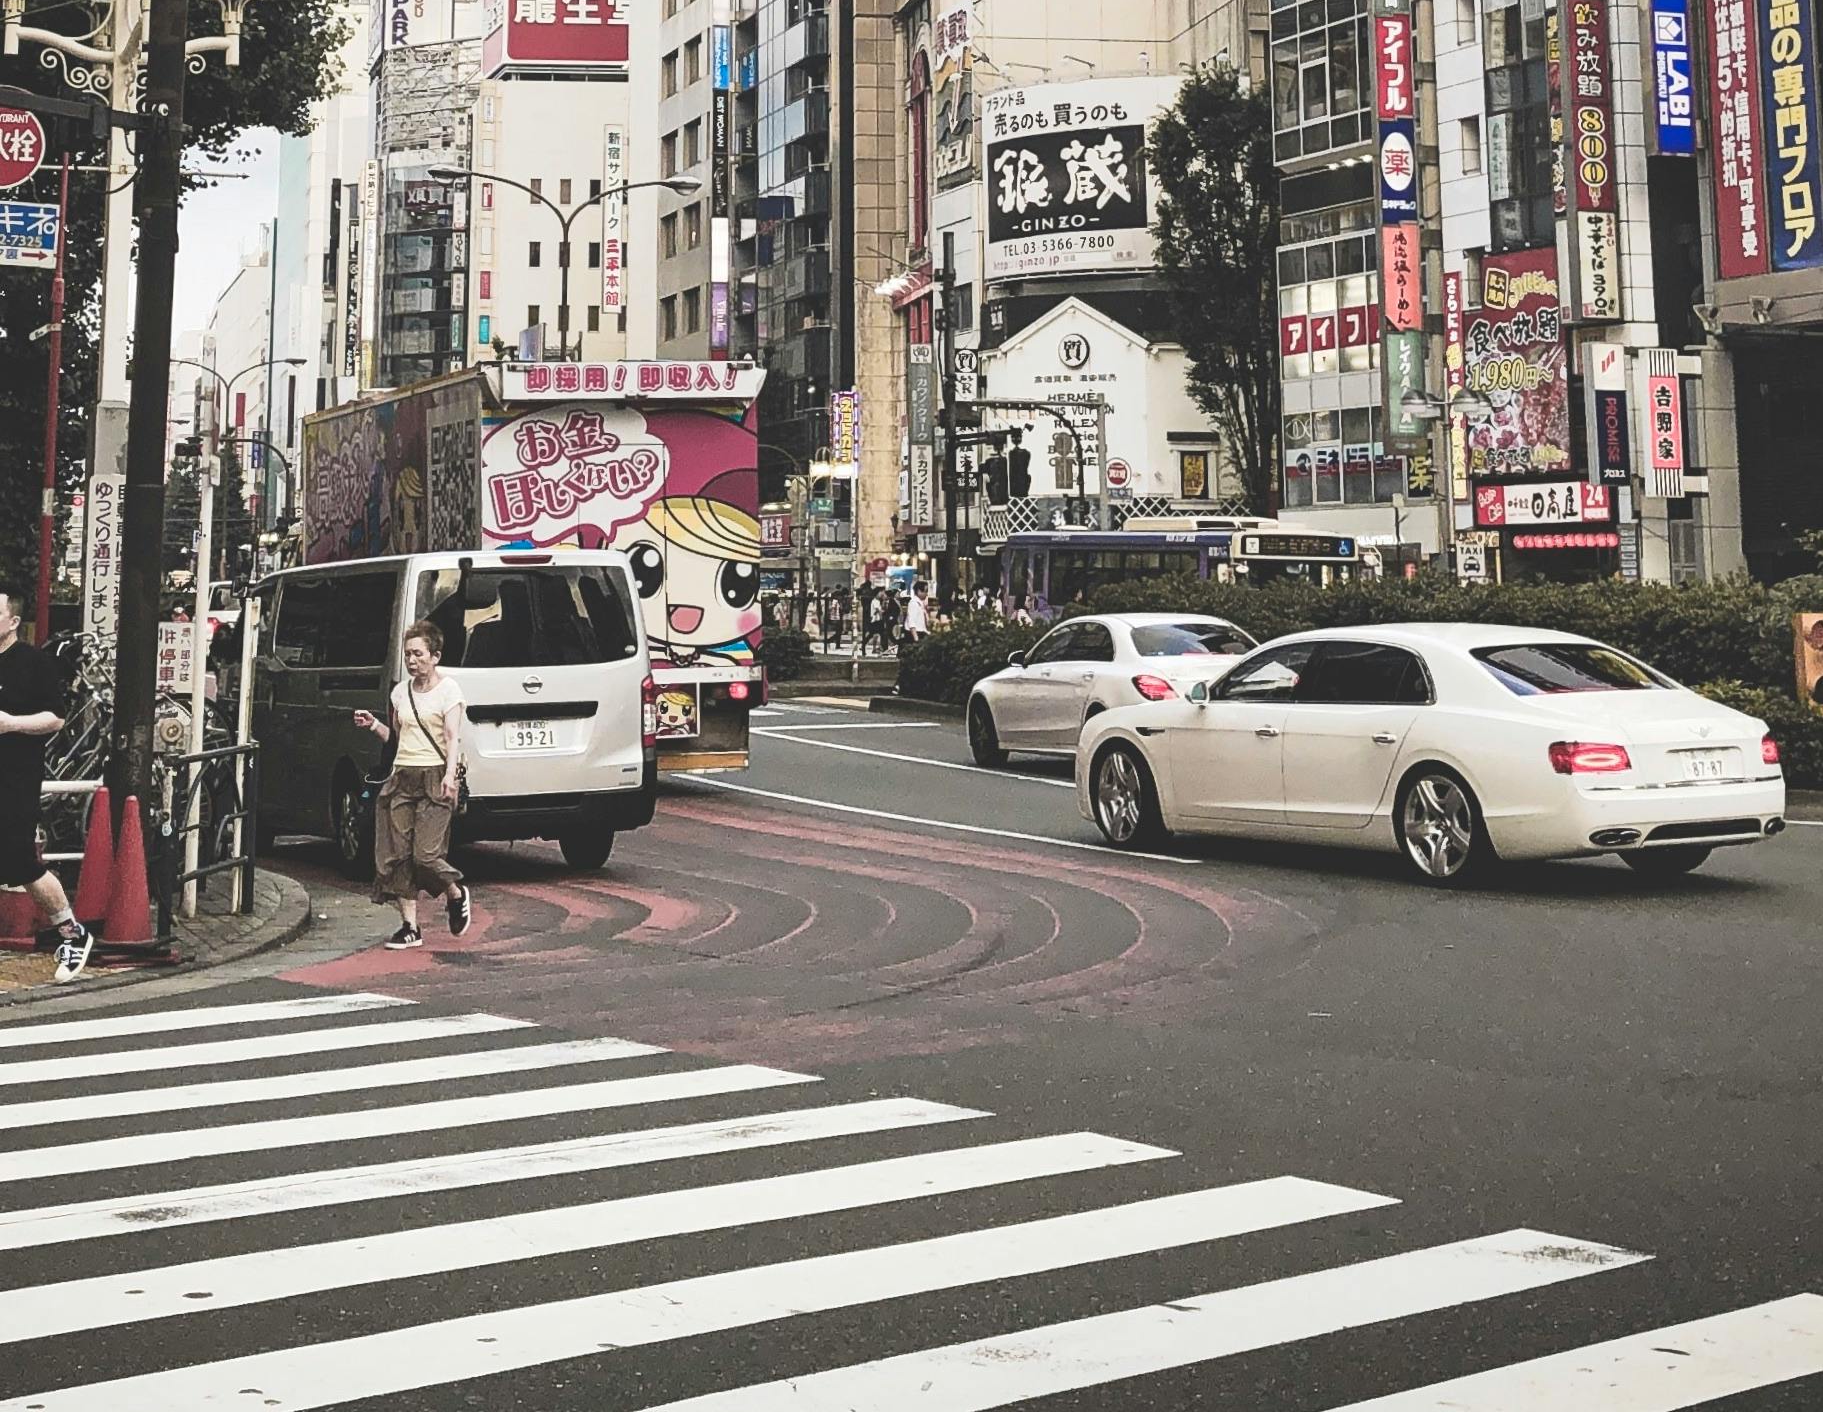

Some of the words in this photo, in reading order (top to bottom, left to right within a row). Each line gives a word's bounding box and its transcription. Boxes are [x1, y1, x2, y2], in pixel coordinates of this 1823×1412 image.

[1383, 20, 1407, 111] アイフル
[1573, 3, 1603, 98] 飲み放題
[986, 91, 1026, 115] ブランド品
[1666, 50, 1692, 127] LABI
[993, 110, 1049, 138] 売るのも
[1052, 101, 1128, 128] 買うのも
[1385, 148, 1411, 176] 薬
[605, 238, 620, 306] 三平本館
[1469, 307, 1560, 357] 食べ放題
[1605, 397, 1621, 464] PROMISE
[1655, 385, 1675, 461] 吉野家
[1586, 485, 1604, 506] 24
[1459, 546, 1483, 556] TAXI
